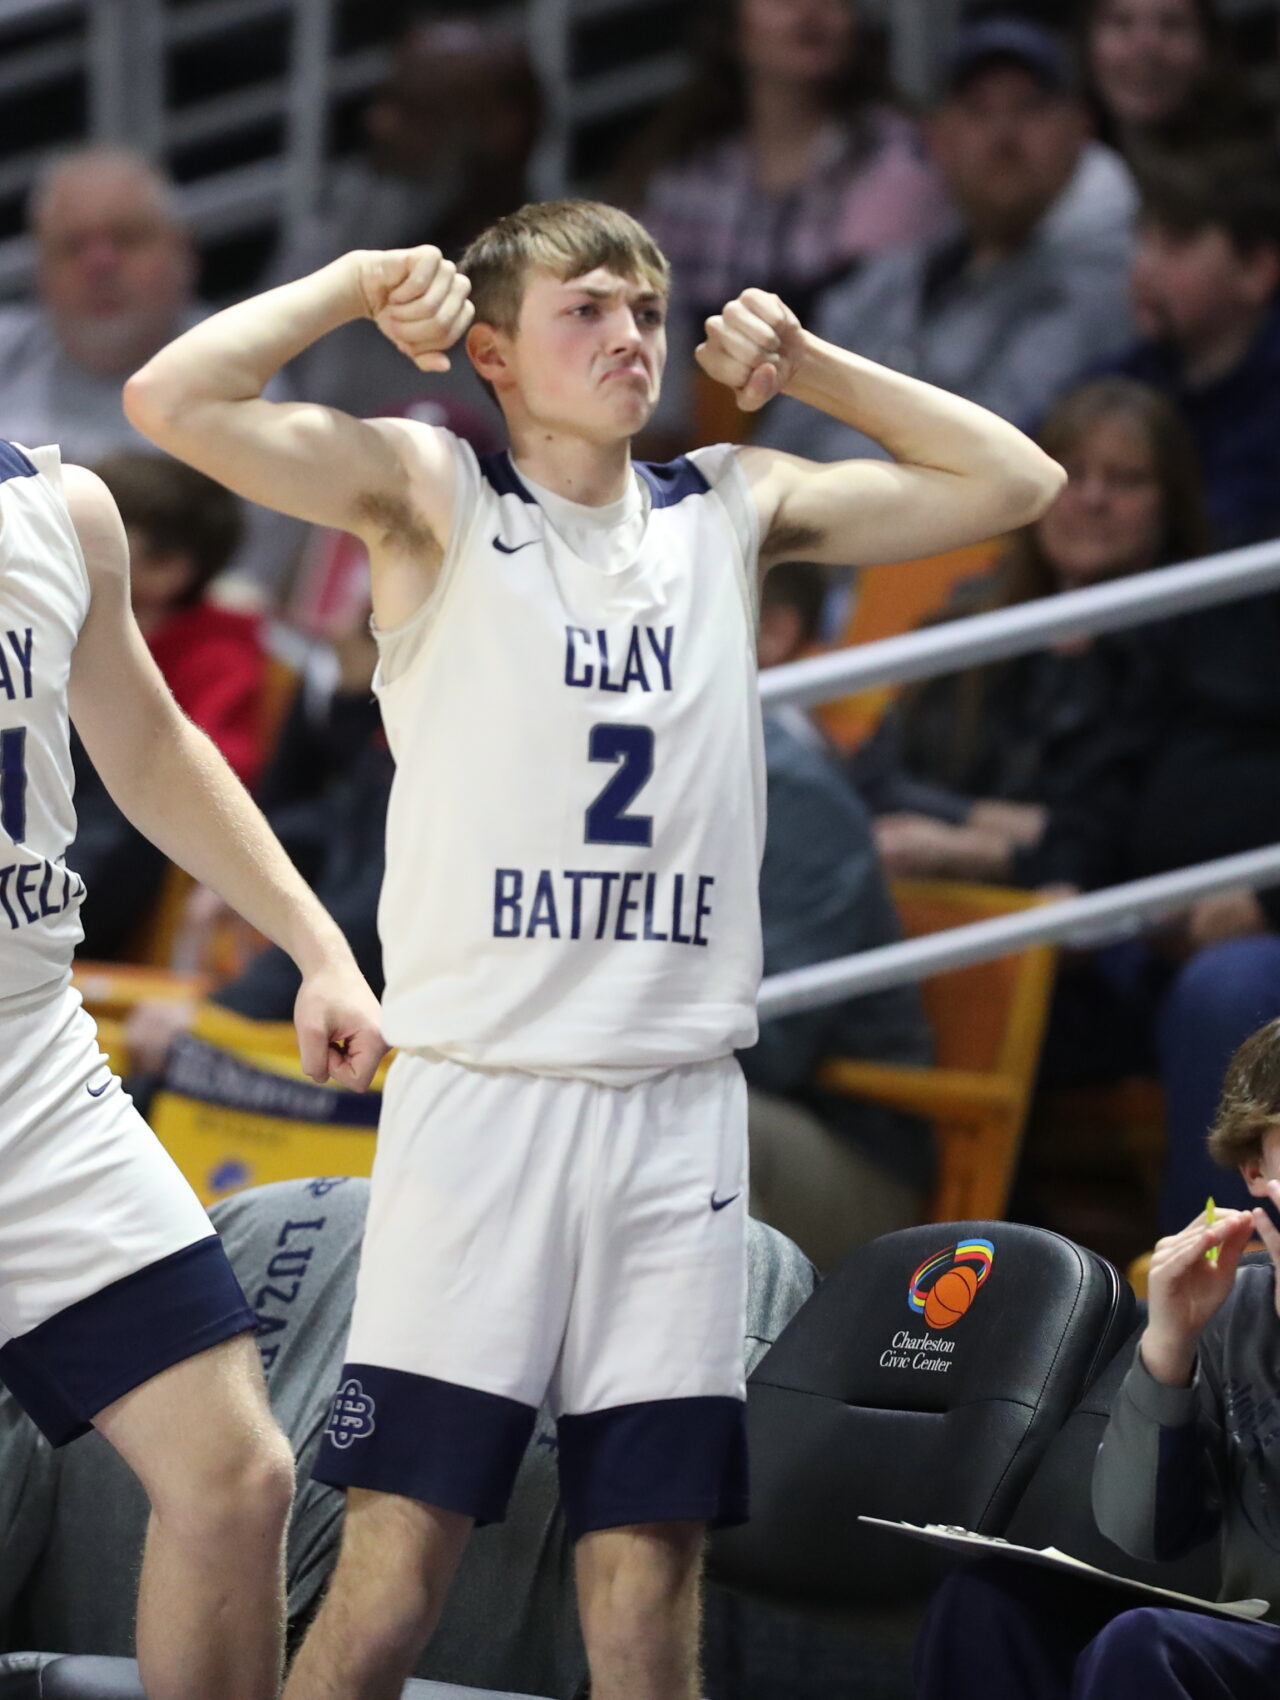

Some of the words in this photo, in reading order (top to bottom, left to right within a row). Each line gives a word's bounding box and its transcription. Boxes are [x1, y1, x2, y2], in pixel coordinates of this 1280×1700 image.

[565, 625, 674, 693] CLAY
[583, 722, 656, 848] 2
[492, 868, 715, 947] BATTELLE
[880, 1350, 910, 1368] Civic
[913, 1352, 952, 1372] Center
[892, 1331, 955, 1352] Charleston
